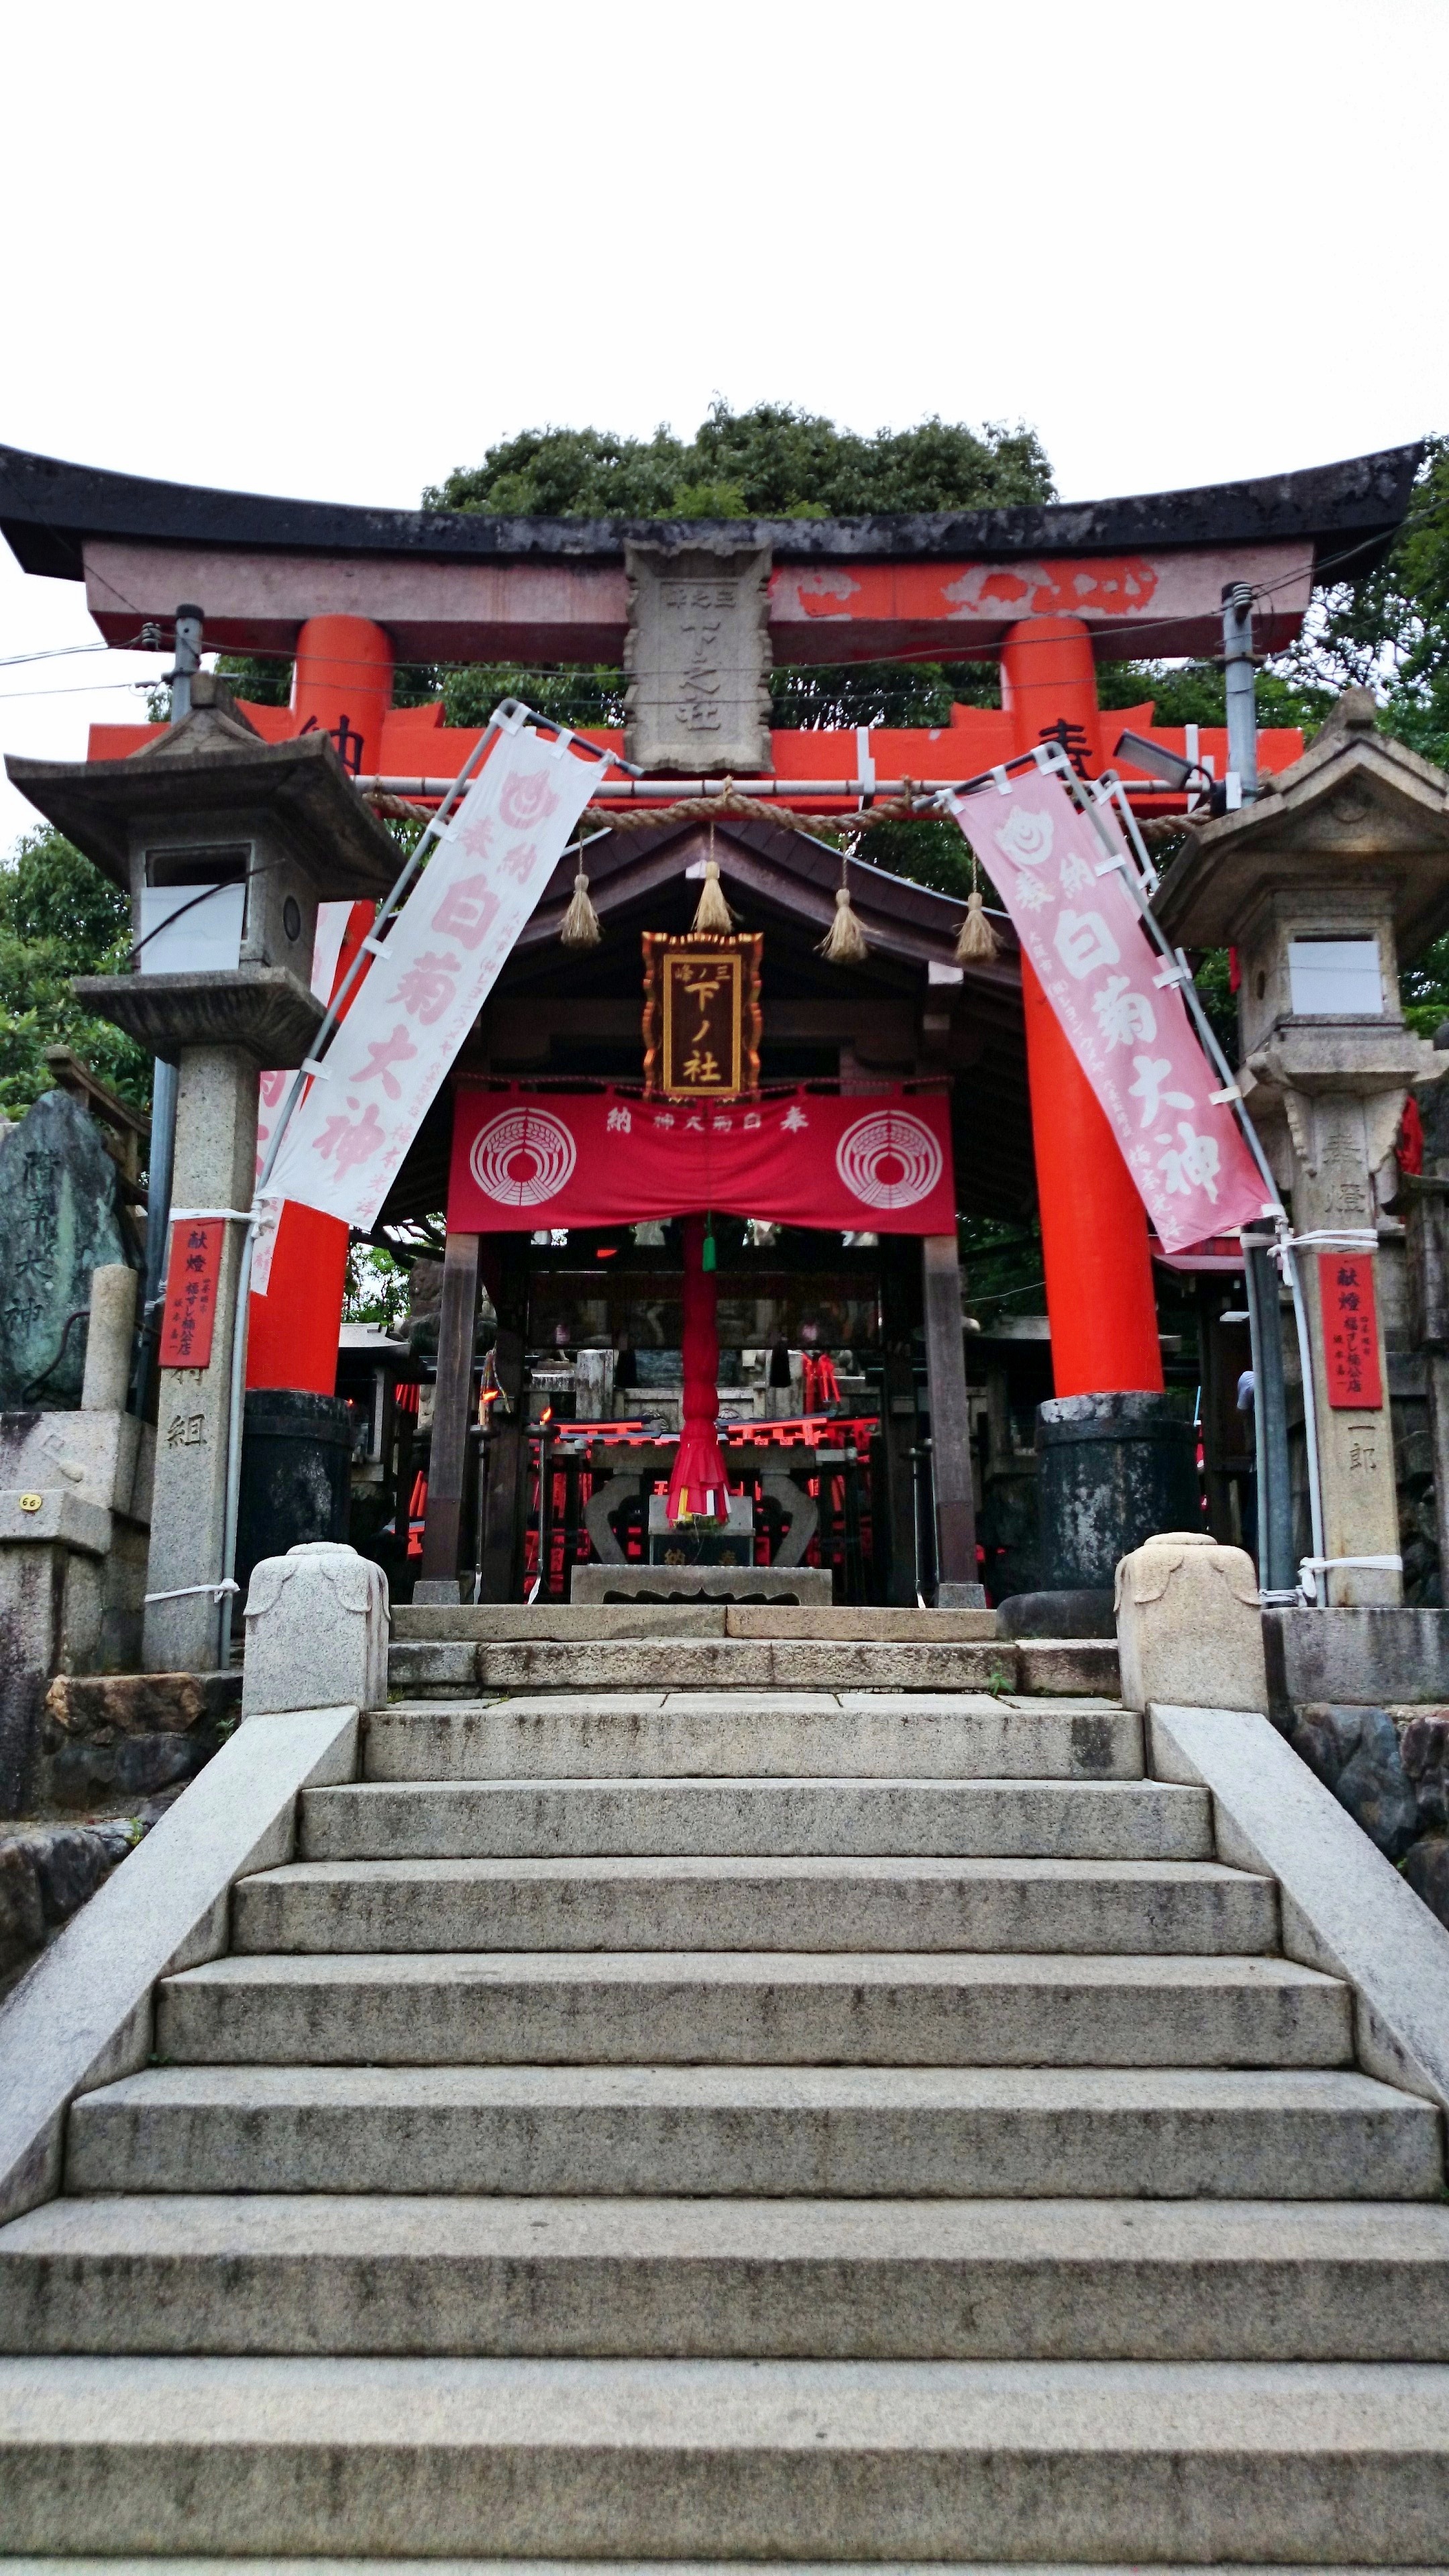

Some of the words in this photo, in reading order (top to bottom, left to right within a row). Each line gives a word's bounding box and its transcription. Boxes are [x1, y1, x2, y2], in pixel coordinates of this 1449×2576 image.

[311, 873, 502, 1186] 白菊大神
[683, 980, 722, 1083] 下ノ社
[1053, 908, 1221, 1205] 白菊大神
